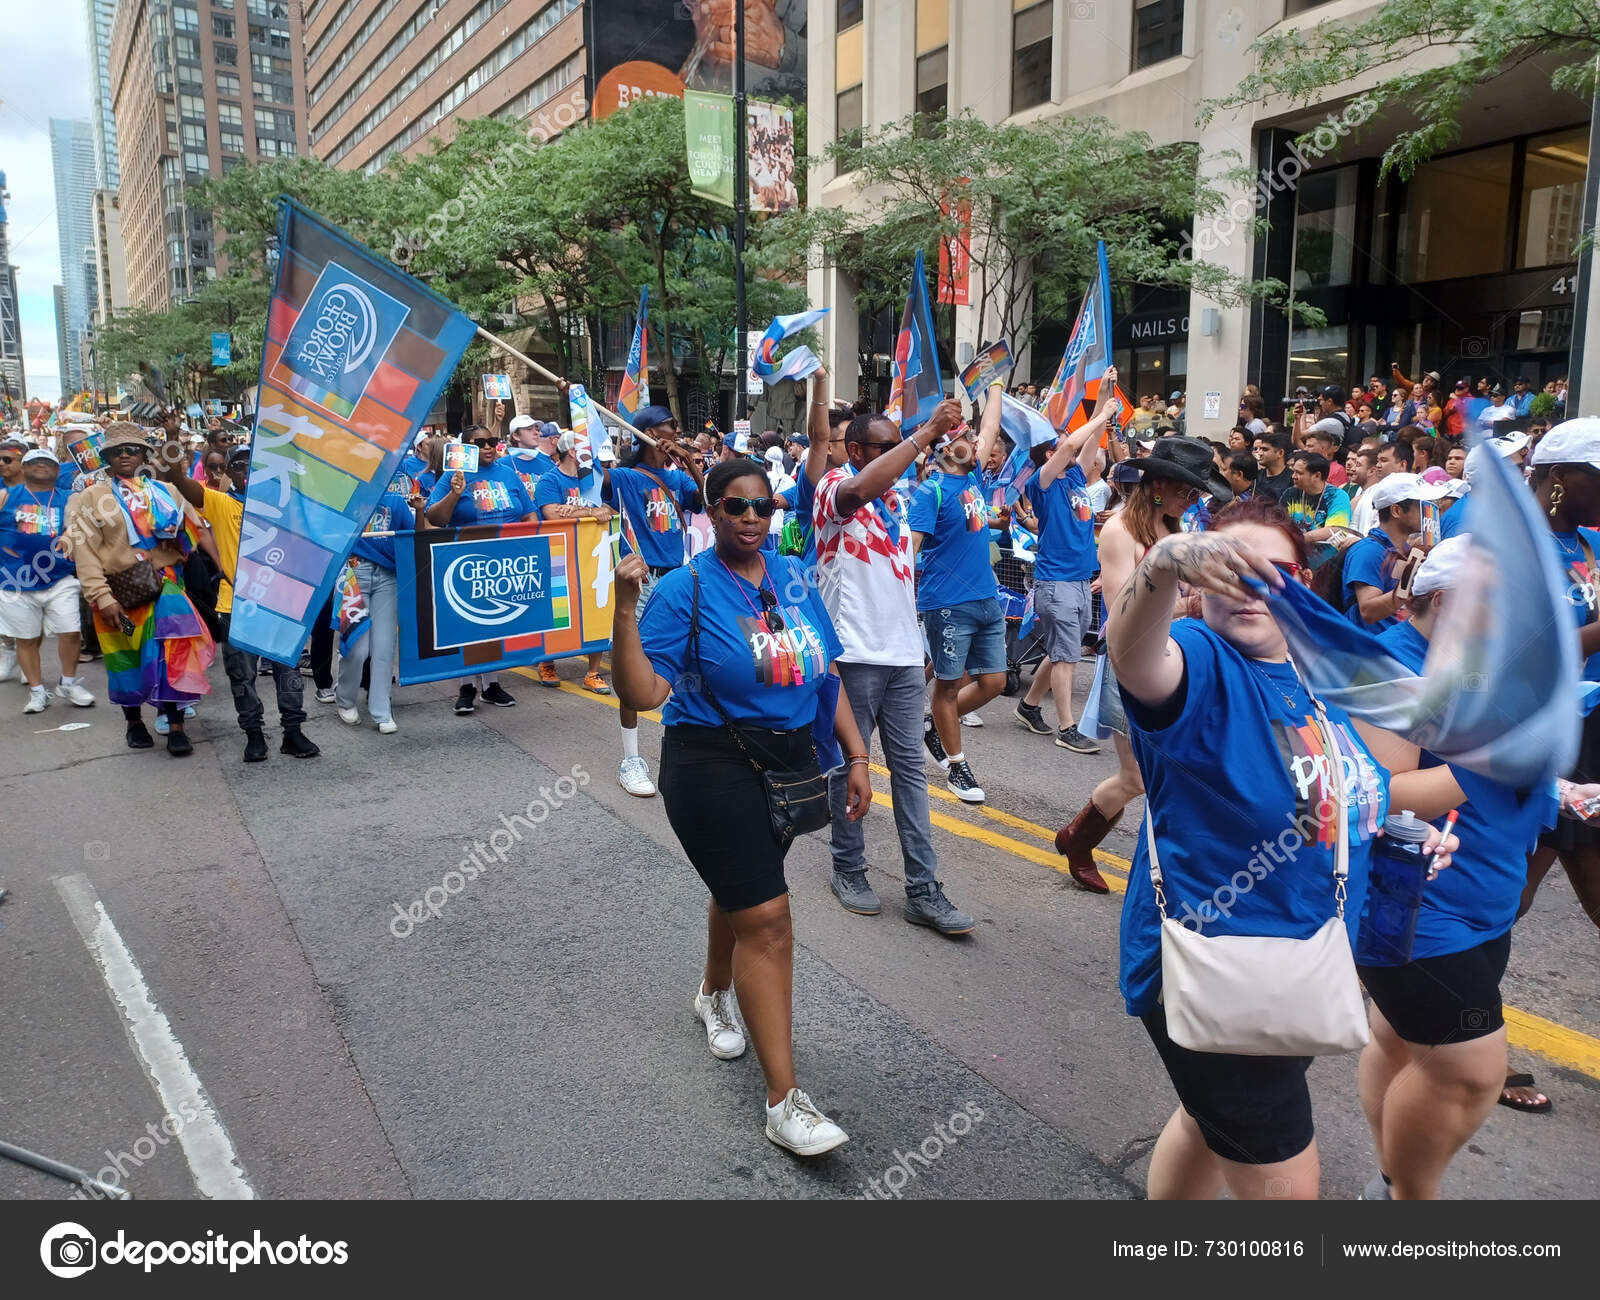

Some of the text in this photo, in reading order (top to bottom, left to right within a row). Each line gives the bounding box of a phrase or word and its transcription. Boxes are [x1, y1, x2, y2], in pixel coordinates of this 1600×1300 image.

[699, 135, 721, 144] MEET
[1131, 318, 1176, 339] NAILS
[473, 487, 508, 501] PRIDE
[646, 500, 679, 520] PRID
[459, 555, 539, 581] GEORGE
[471, 573, 543, 599] BROWN
[511, 590, 545, 602] COLLEGE
[750, 625, 820, 660] PRIDE
[1290, 753, 1381, 802] PRDE
